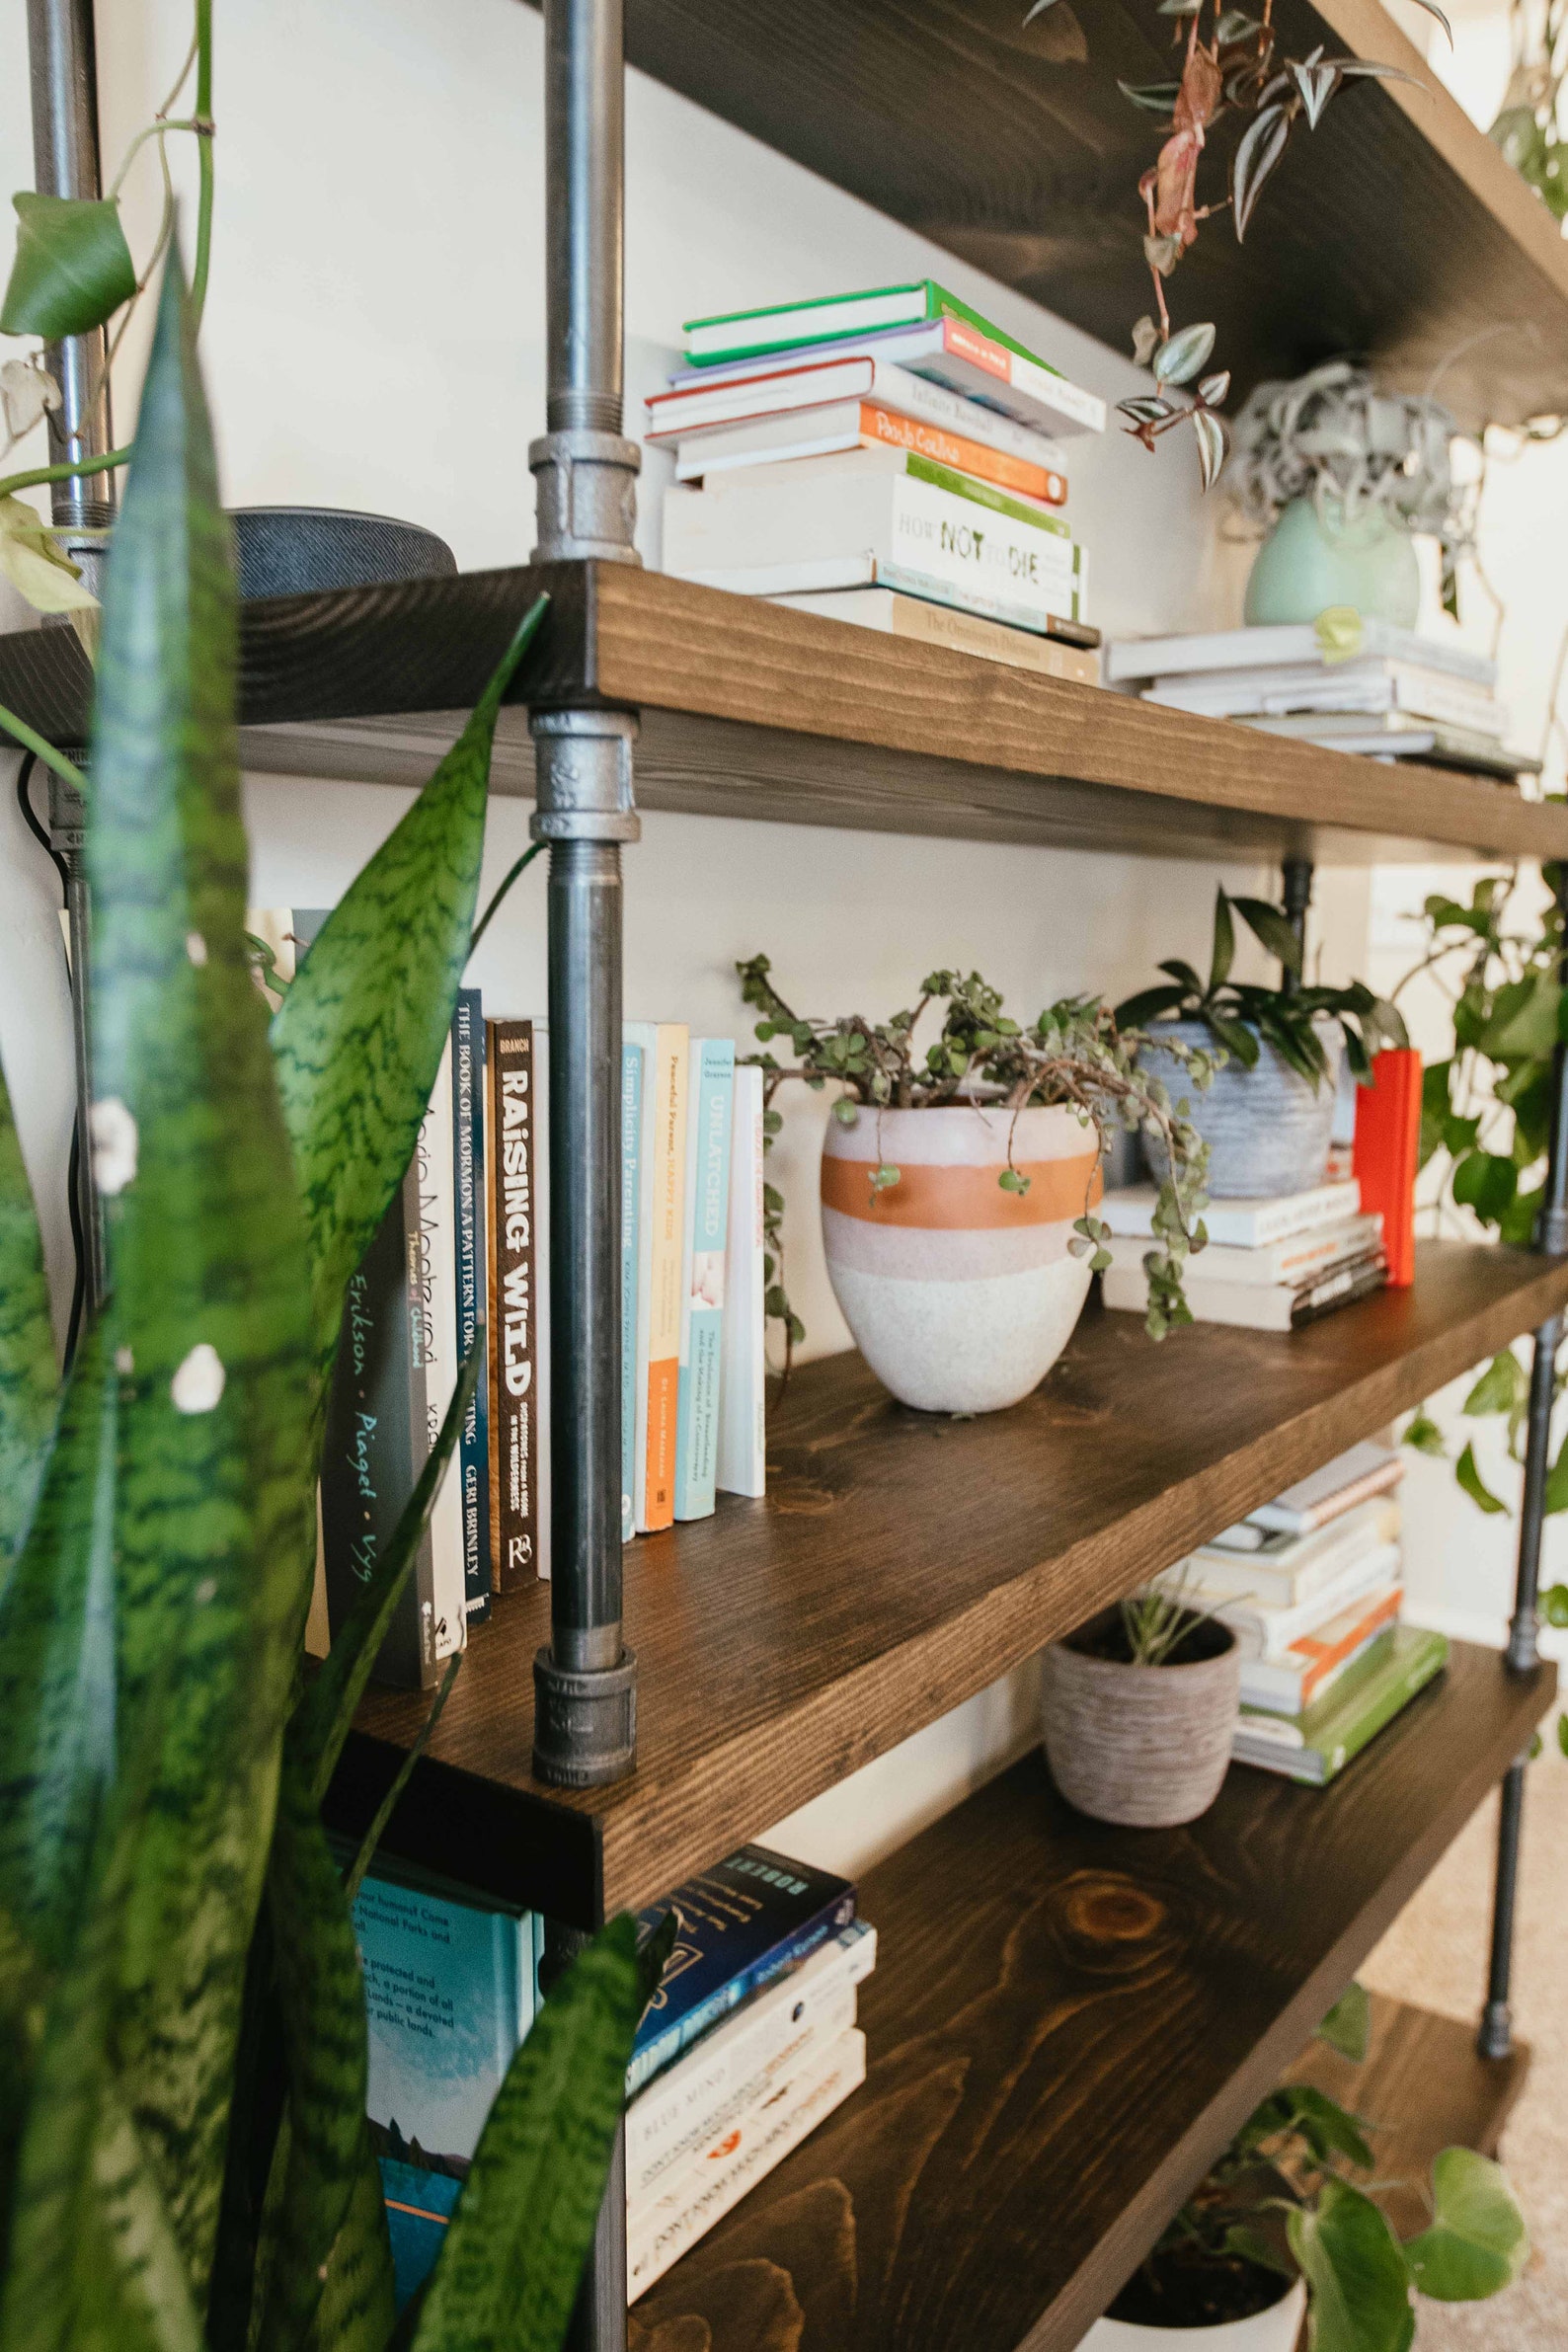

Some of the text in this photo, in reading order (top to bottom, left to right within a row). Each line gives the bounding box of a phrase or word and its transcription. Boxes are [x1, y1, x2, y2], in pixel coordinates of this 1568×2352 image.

[899, 512, 937, 540] HOW
[940, 520, 984, 562] NOT
[1008, 545, 1040, 585] DIE
[458, 1002, 471, 1040] THE
[500, 1037, 529, 1054] BRANCH
[459, 1045, 471, 1095] BOOK
[669, 1055, 678, 1108] Peaceful
[460, 1098, 472, 1121] OF
[460, 1126, 473, 1209] MORMON
[620, 1056, 640, 1248] Simplicity Parenting
[704, 1094, 726, 1237] UNLATCHED
[461, 1213, 473, 1227] A
[461, 1230, 475, 1307] PATTERN
[351, 1273, 375, 1376] Erikson
[407, 1230, 424, 1369] Theories of Childhood
[463, 1311, 476, 1346] FOR
[505, 1262, 532, 1397] WILD
[346, 1411, 377, 1499] Piaget
[510, 1425, 519, 1444] THE
[510, 1444, 520, 1512] WILDERNESS
[465, 1464, 480, 1577] GERI BRINLEY
[725, 1854, 809, 1896] ROBERT
[359, 1904, 399, 1927] National
[402, 1919, 429, 1937] Parks
[431, 1930, 450, 1944] and
[371, 1959, 415, 1982] protected
[417, 1976, 435, 1990] and
[393, 1982, 427, 2002] portion
[429, 1995, 439, 2007] of
[441, 1998, 453, 2011] all
[377, 2009, 405, 2028] public
[416, 2005, 454, 2029] devoted
